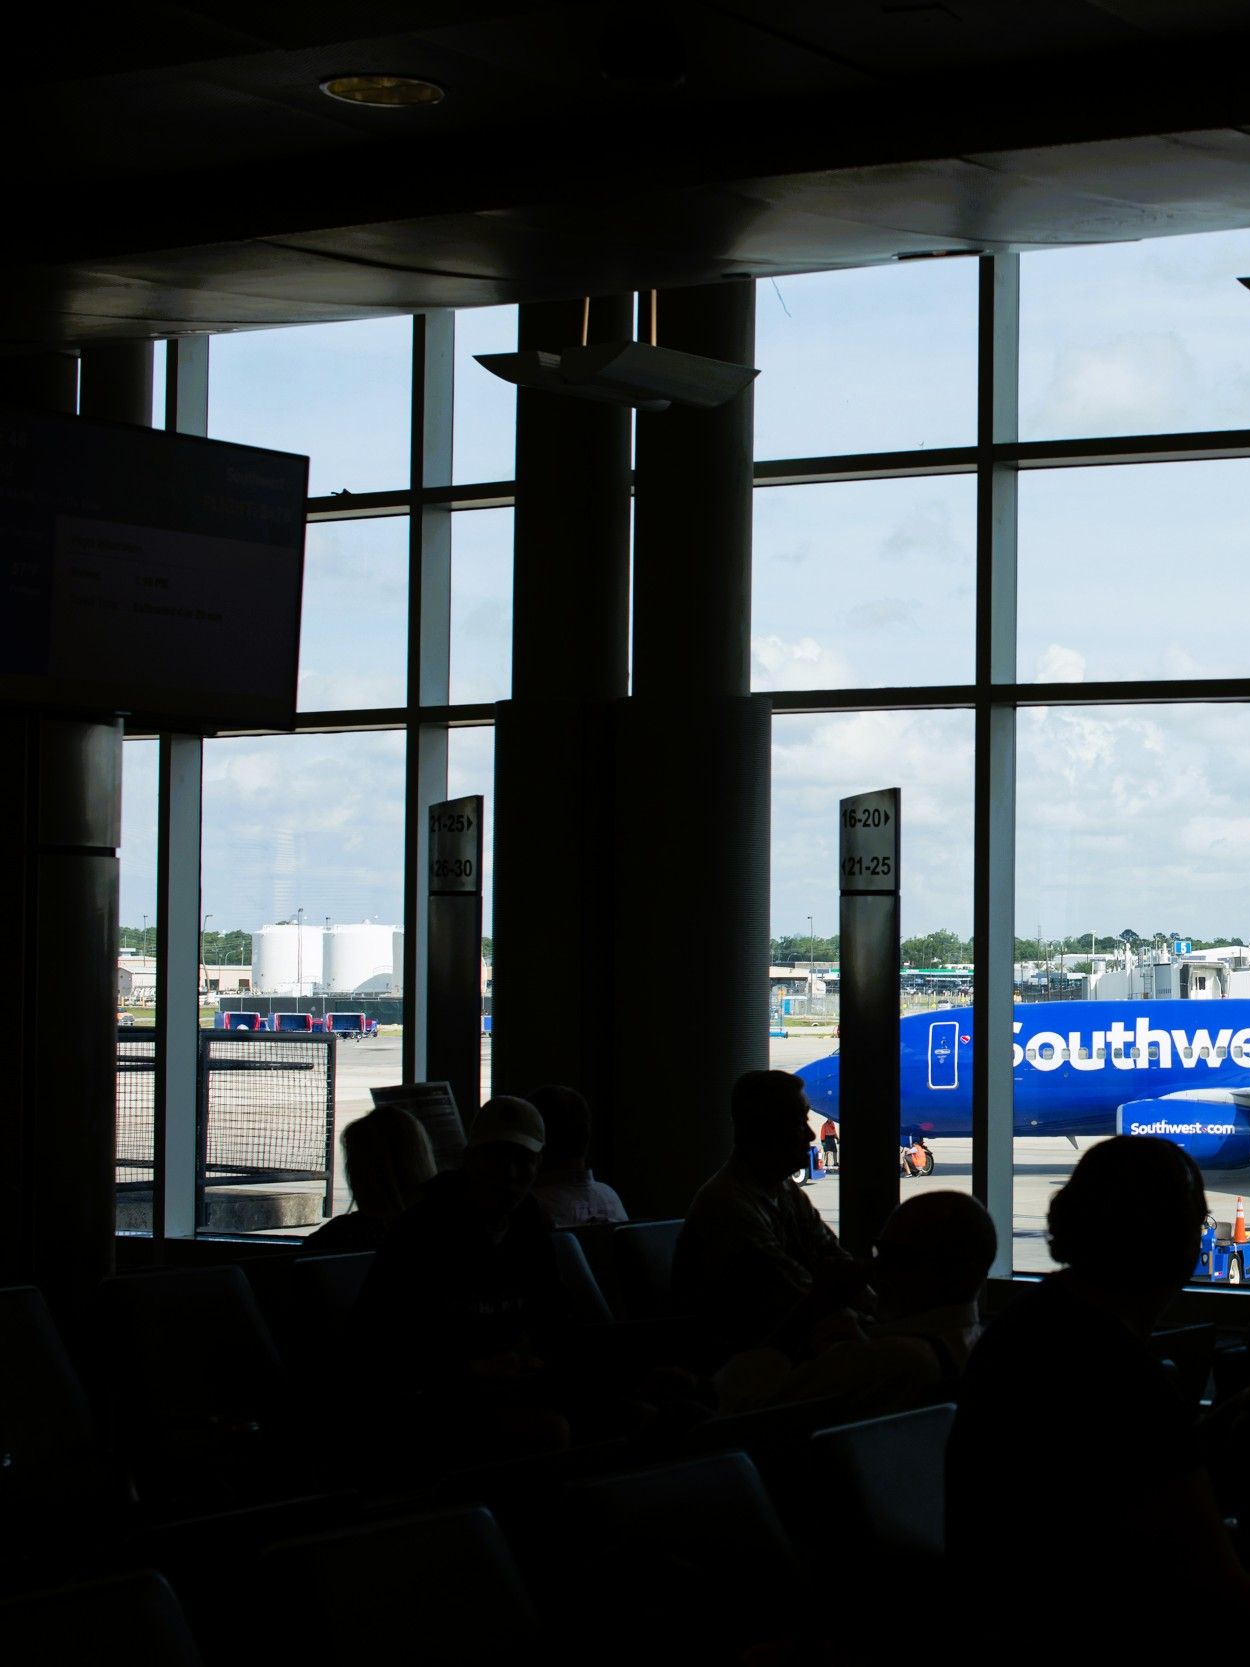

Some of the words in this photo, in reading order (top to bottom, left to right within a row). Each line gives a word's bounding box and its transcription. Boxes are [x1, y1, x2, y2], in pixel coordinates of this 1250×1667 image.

[430, 814, 465, 833] 21-25
[842, 808, 881, 828] 16-20
[434, 859, 472, 877] 26-30
[847, 856, 891, 876] 21-25
